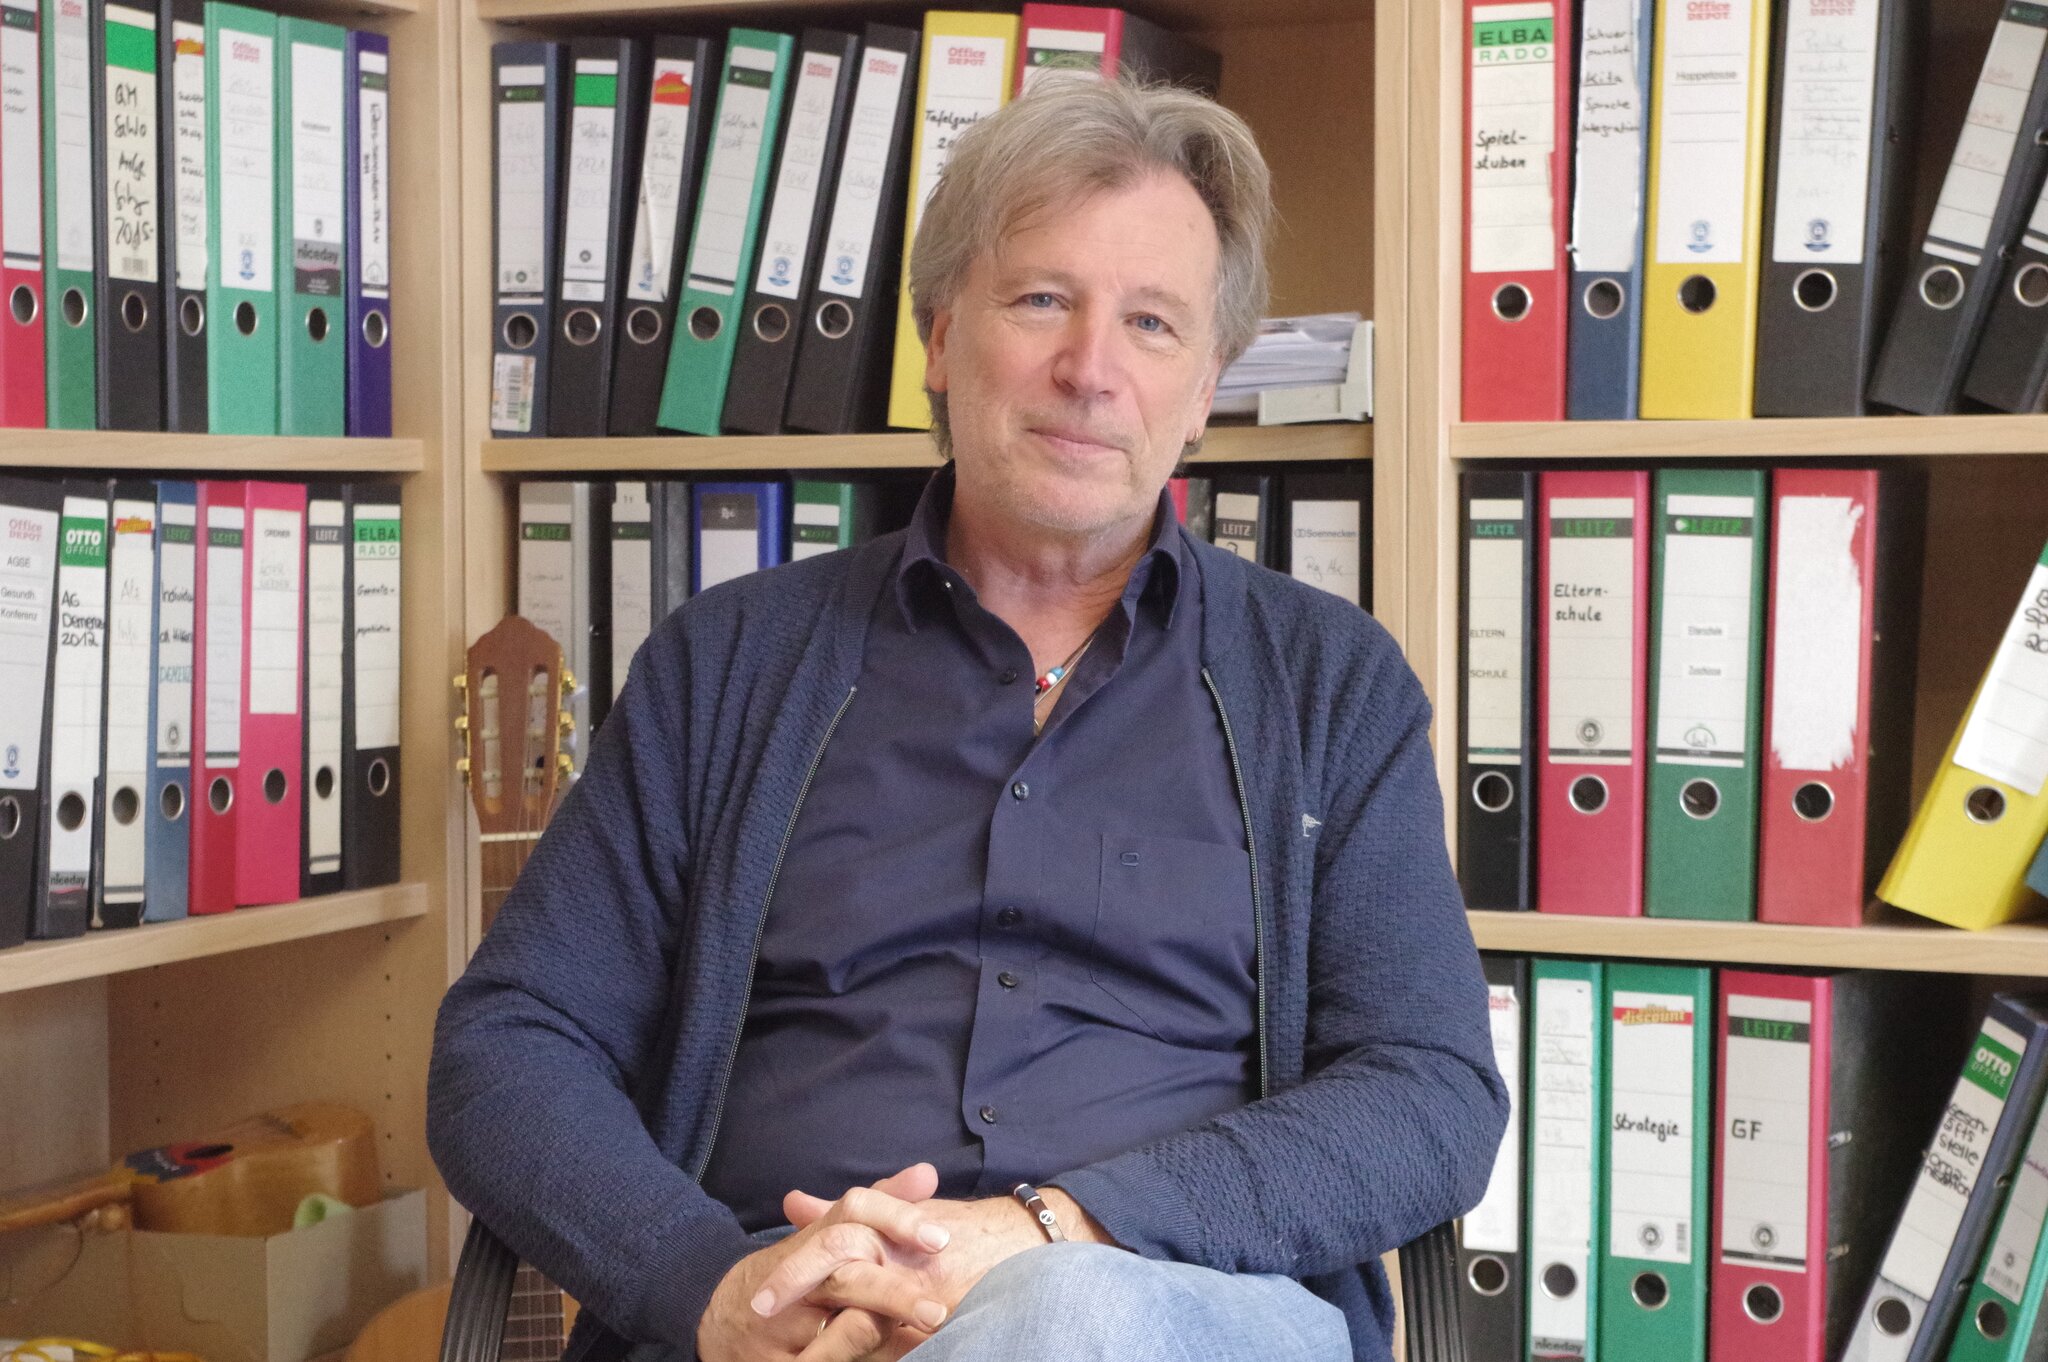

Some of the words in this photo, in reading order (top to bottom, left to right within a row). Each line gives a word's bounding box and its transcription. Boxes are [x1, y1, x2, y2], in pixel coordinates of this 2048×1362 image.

[1687, 1, 1730, 12] Office
[1810, 8, 1853, 16] DEPOT
[1687, 12, 1729, 20] DEPOT
[1479, 28, 1547, 45] ELBA
[949, 47, 986, 57] Office
[1479, 47, 1548, 61] RADO
[948, 58, 985, 66] DEPOT
[1583, 72, 1623, 86] Kita
[1474, 131, 1526, 151] Spiel-
[1474, 157, 1526, 169] stuben
[297, 244, 338, 265] niceday
[9, 519, 42, 532] Office
[1222, 523, 1250, 536] LEITZ
[1476, 524, 1516, 535] LEITZ
[1565, 521, 1616, 536] LEITZ
[1689, 519, 1743, 534] LEITZ
[9, 531, 41, 541] DEPOT
[66, 530, 101, 544] OTTO
[315, 530, 338, 541] LEITZ
[358, 527, 396, 541] ELBA
[1305, 528, 1357, 538] Soennecken
[65, 546, 100, 556] OFFICE
[358, 545, 397, 557] RADO
[1554, 584, 1609, 598] Eltern-
[61, 590, 80, 608] AG
[1, 608, 38, 622] Konferenz
[1555, 606, 1603, 621] schule
[61, 632, 100, 647] 2012
[1469, 629, 1506, 638] ELTERN
[1469, 669, 1509, 679] SCHULE
[49, 872, 86, 889] niceday
[1622, 1009, 1685, 1026] discount
[1743, 1019, 1795, 1040] LEITZ
[1974, 1047, 2012, 1077] OTTO
[1971, 1063, 2006, 1088] OFFICE
[1612, 1111, 1680, 1143] Strategie
[1731, 1118, 1764, 1141] GF
[1534, 1337, 1583, 1355] niceday
